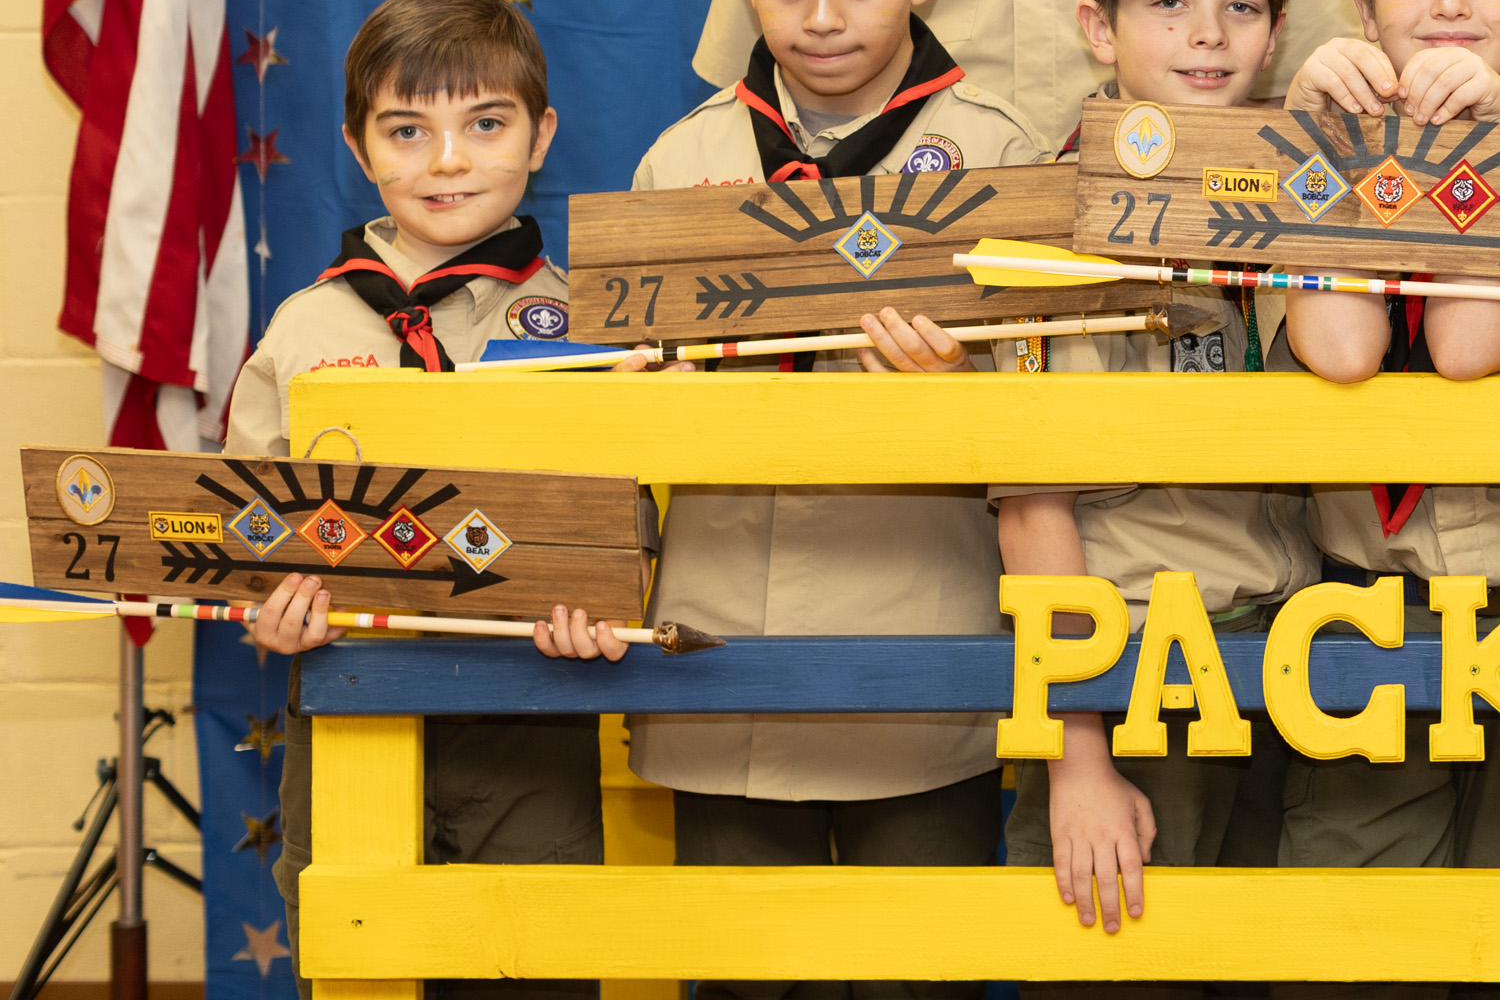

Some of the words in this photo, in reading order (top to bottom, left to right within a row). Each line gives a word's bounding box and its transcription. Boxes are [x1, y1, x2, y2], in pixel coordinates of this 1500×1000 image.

[1224, 177, 1260, 193] LION
[1301, 192, 1330, 201] BOBCAT
[1452, 203, 1475, 211] WOLF
[1107, 190, 1172, 246] 27
[853, 249, 882, 259] BOBCAT
[603, 275, 664, 329] 27
[337, 354, 380, 368] BSA
[170, 520, 206, 534] LION
[247, 534, 275, 543] BOBCAT
[394, 544, 416, 552] WOLF
[465, 546, 491, 556] BEAR
[62, 532, 121, 583] 27
